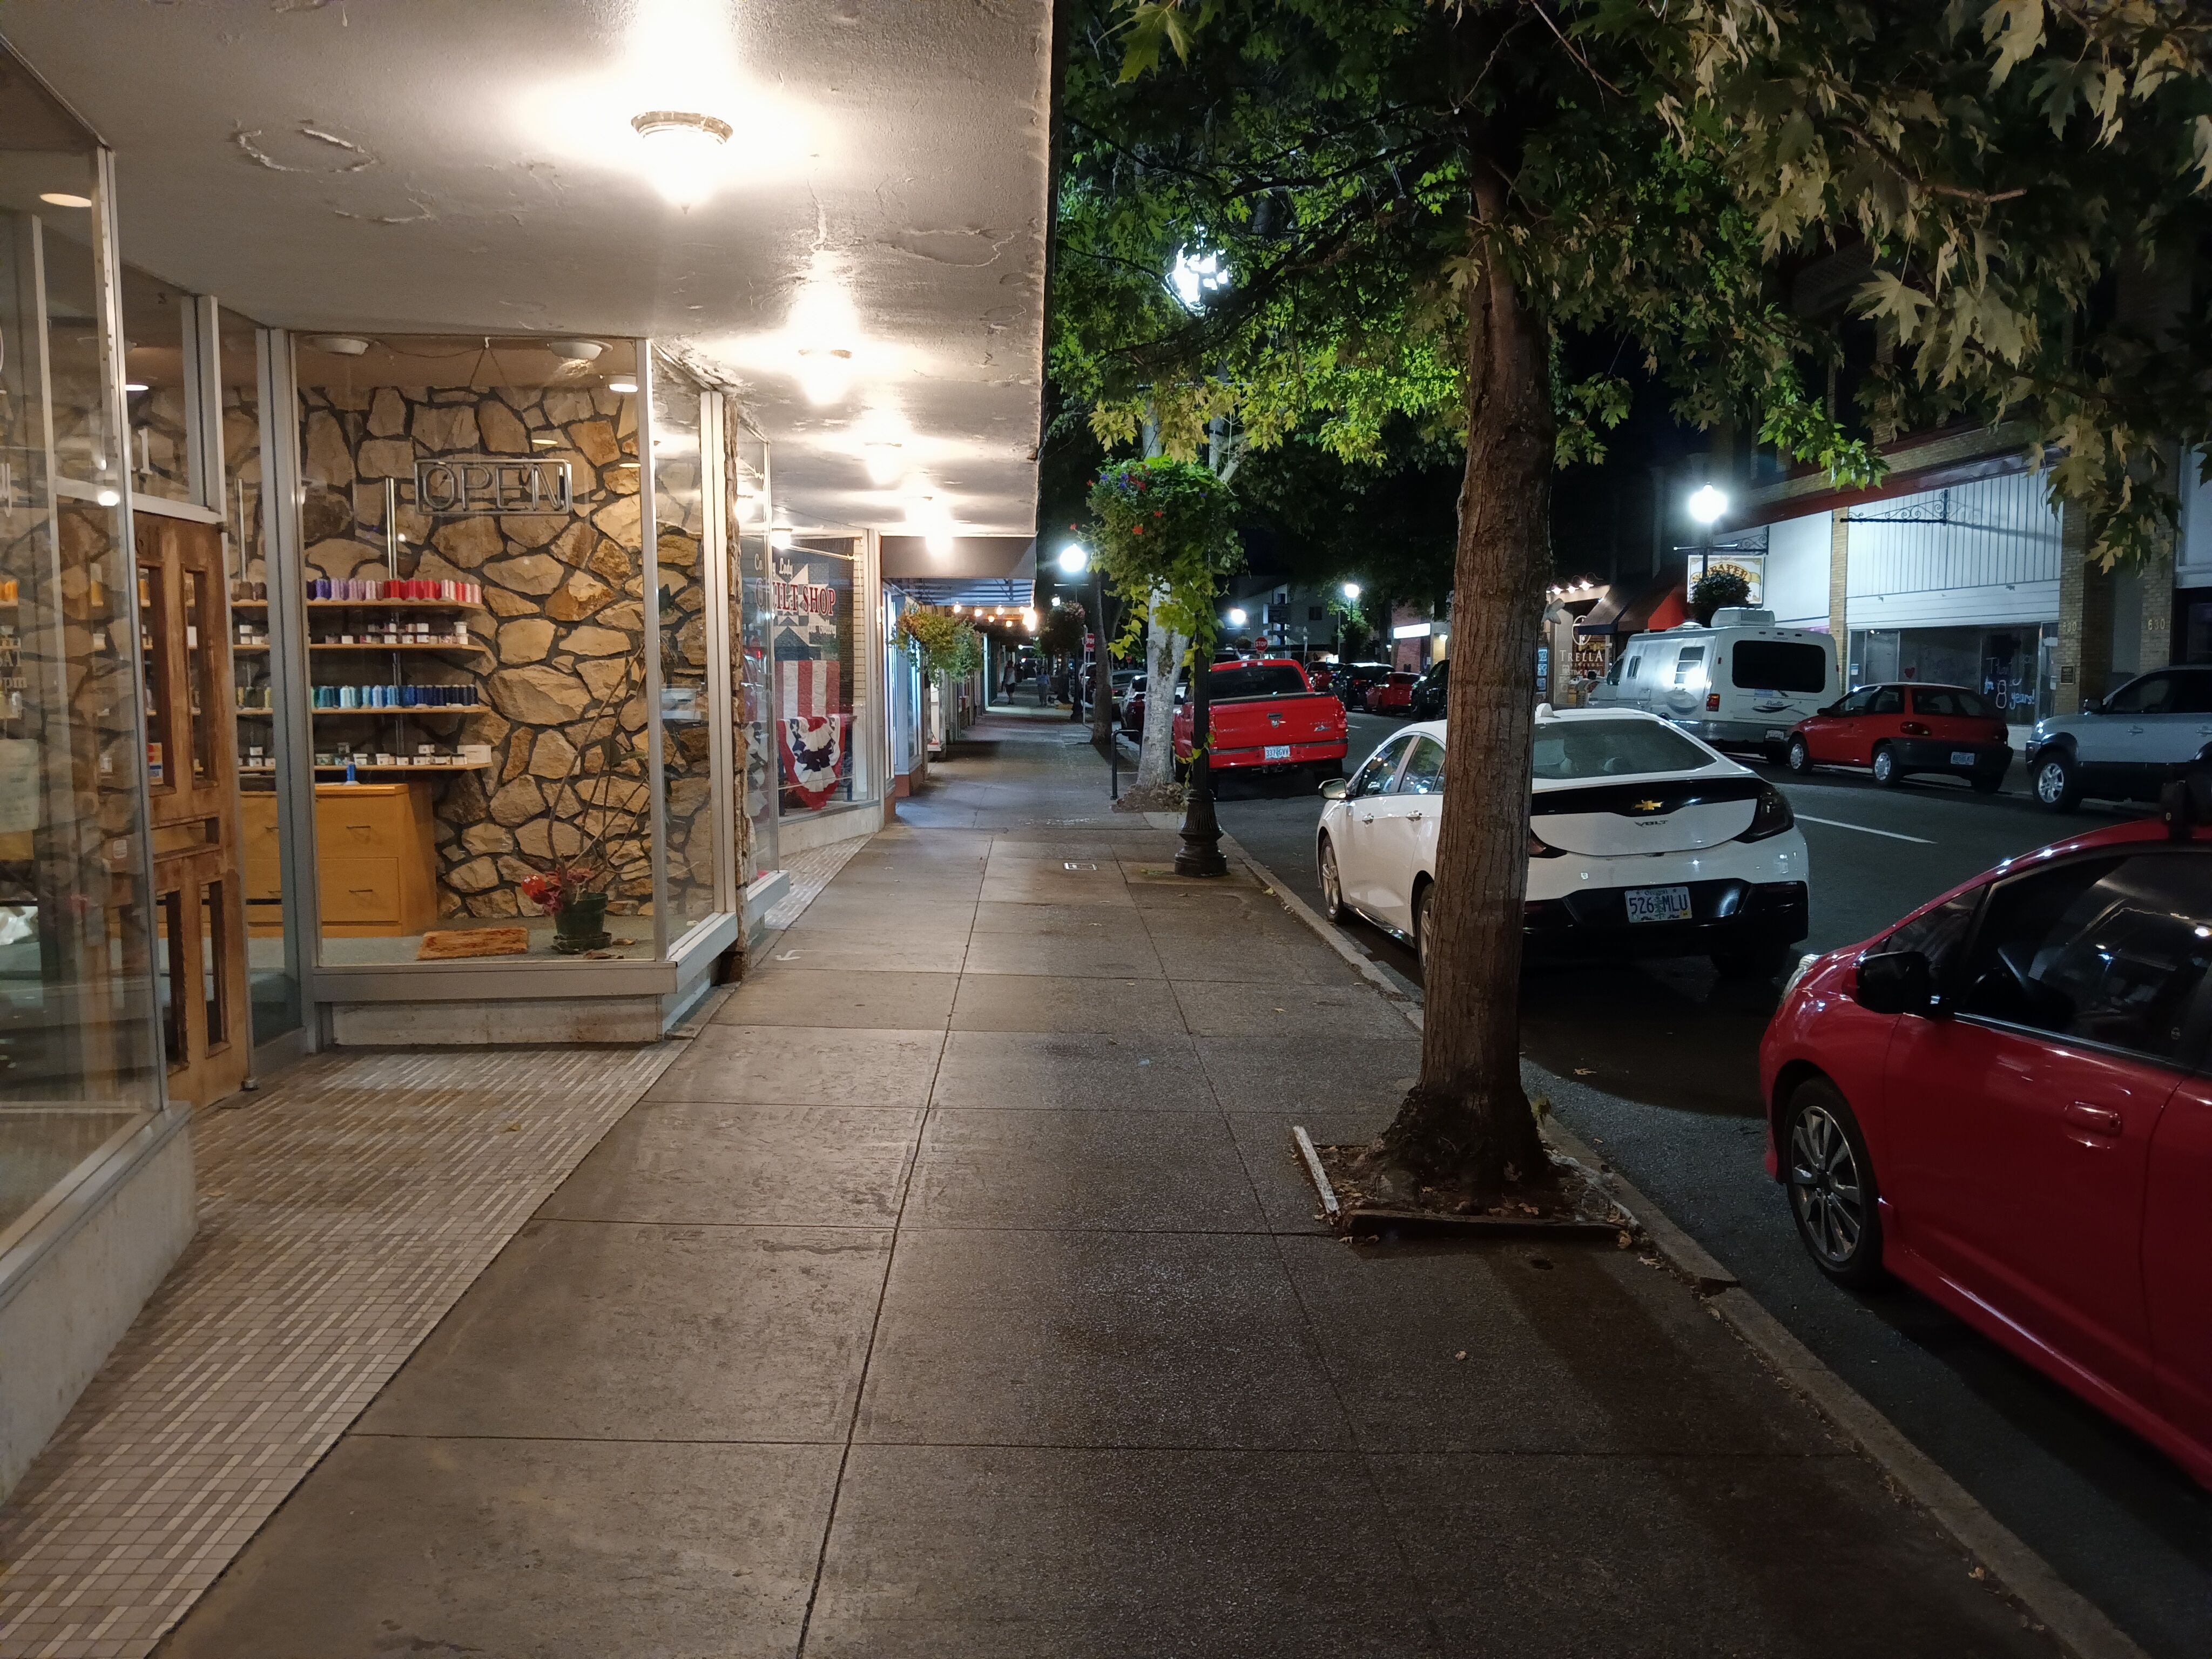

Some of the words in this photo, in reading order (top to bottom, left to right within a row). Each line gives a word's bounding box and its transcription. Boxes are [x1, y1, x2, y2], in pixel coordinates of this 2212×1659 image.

[423, 463, 564, 512] OPEN
[802, 585, 835, 615] SHOP
[2148, 618, 2166, 631] 630
[0, 649, 21, 667] AT
[1560, 650, 1603, 662] TRELLA
[1995, 679, 2007, 709] 8
[1634, 820, 1668, 828] VOLT
[1629, 896, 1654, 915] 526
[1662, 893, 1688, 913] MLU
